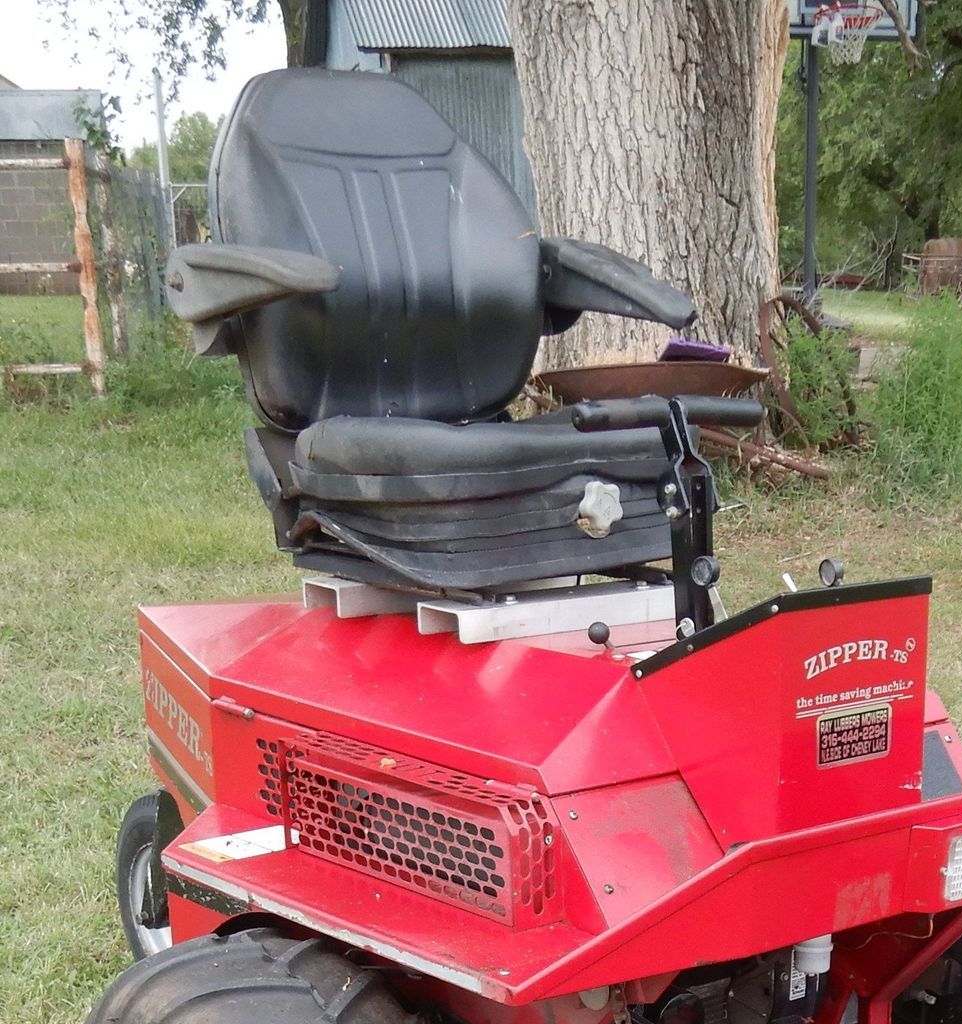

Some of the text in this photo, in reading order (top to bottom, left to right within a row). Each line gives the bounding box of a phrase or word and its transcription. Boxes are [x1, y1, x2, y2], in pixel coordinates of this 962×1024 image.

[804, 639, 889, 680] ZIPPER
[797, 679, 914, 709] the time saving machie
[145, 669, 201, 761] ZIPPER
[820, 720, 833, 734] RAY
[861, 709, 888, 727] MOWERS
[842, 744, 851, 758] OF
[851, 740, 872, 756] CHENEY
[872, 737, 886, 752] LAKE
